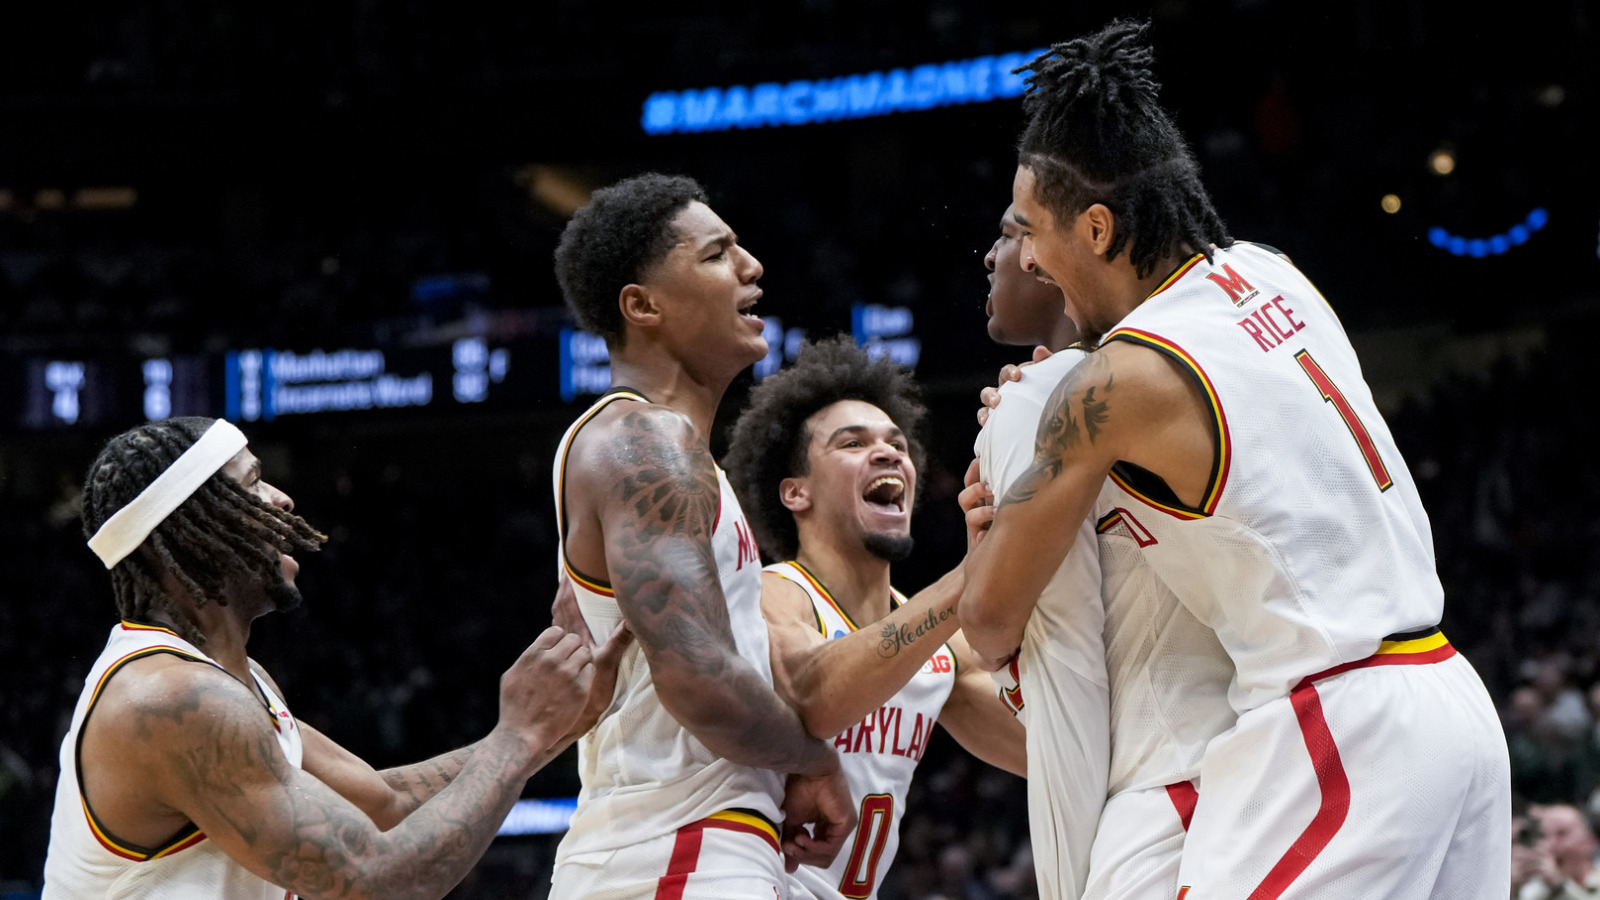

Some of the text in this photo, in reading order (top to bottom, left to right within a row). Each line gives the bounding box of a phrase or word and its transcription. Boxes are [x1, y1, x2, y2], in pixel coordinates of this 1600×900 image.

[1205, 262, 1256, 305] M
[1236, 294, 1306, 353] RICE
[1293, 348, 1394, 493] 1
[877, 606, 957, 659] Heather
[834, 706, 935, 763] ARYLA
[838, 793, 894, 899] 0
